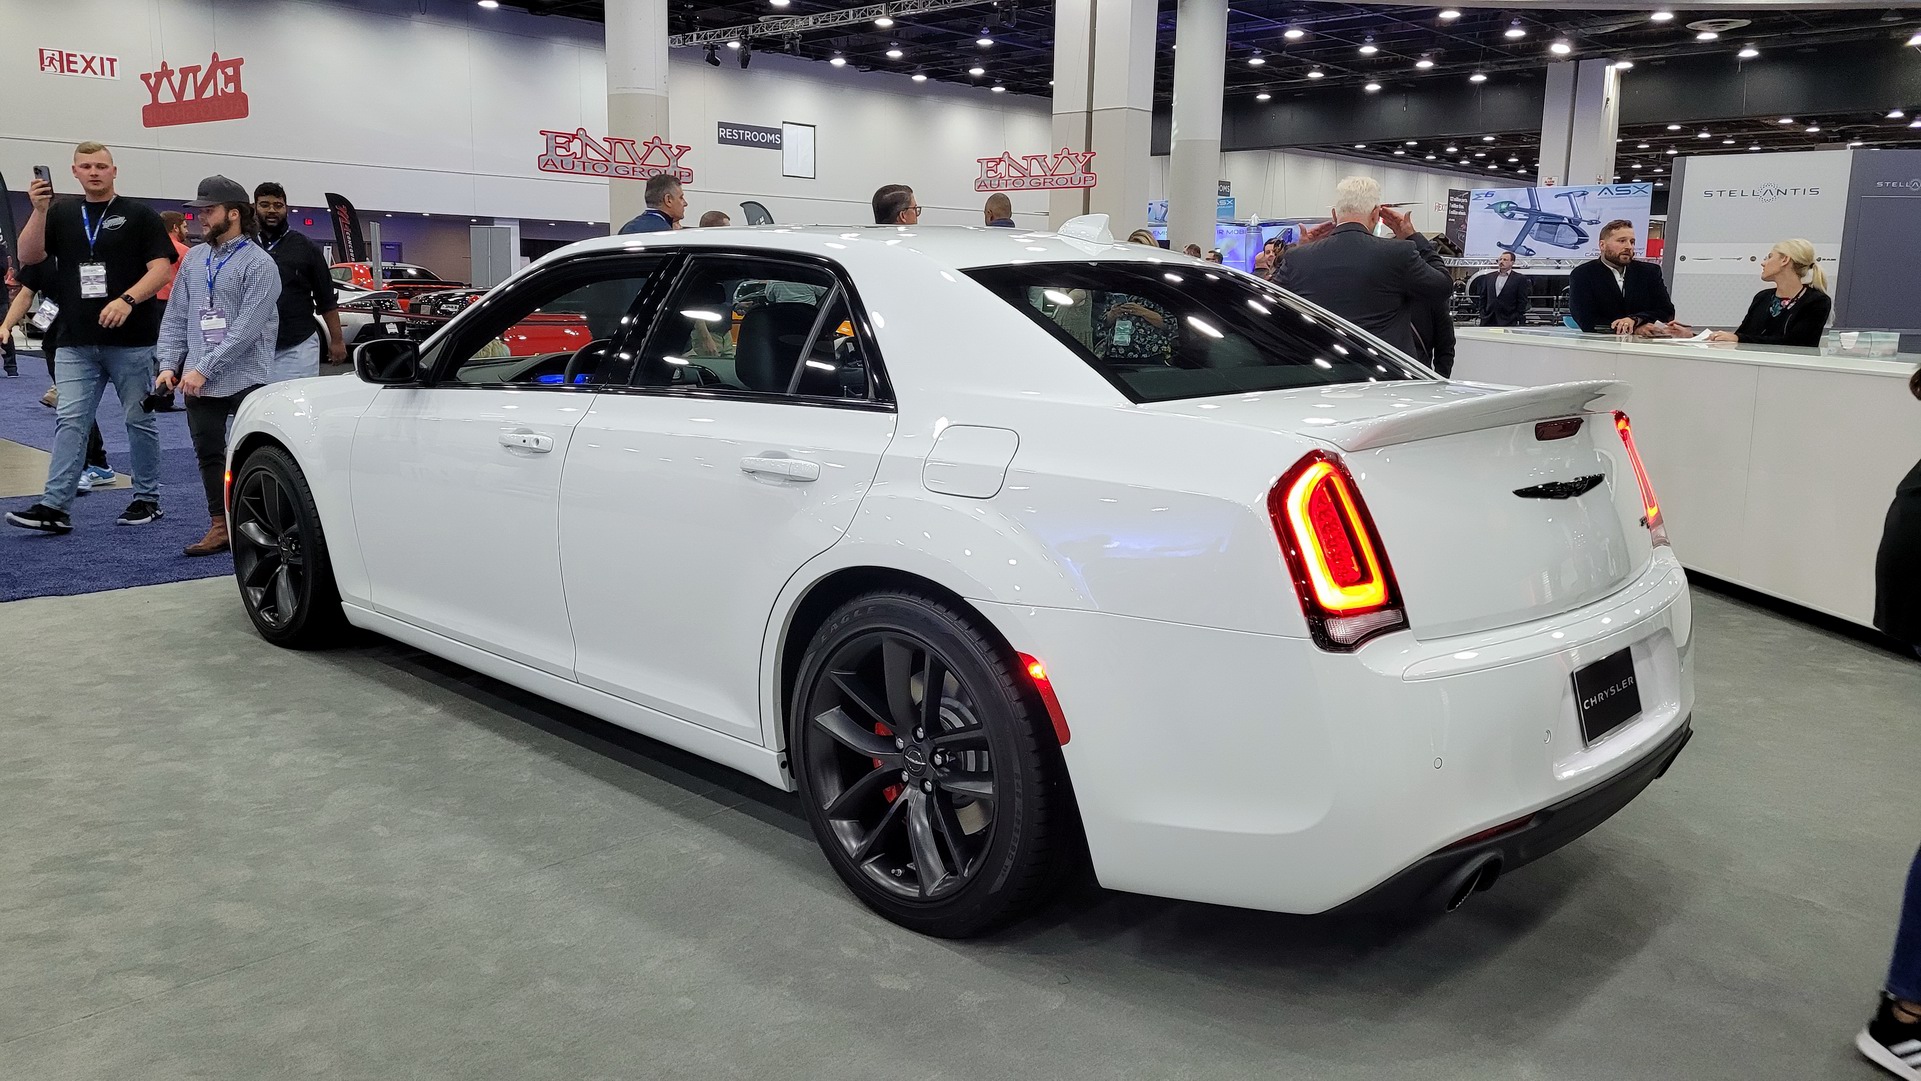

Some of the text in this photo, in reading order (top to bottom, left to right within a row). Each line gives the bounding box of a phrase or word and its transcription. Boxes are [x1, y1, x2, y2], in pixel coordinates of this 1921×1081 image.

[65, 53, 118, 78] EXIT
[718, 127, 782, 144] RESTROOMS
[539, 129, 692, 168] ENVY
[542, 158, 609, 174] AUTO
[976, 151, 1097, 178] ENVY
[976, 175, 1095, 190] AUTO GROUP
[1597, 184, 1650, 197] ASX
[1703, 186, 1821, 198] STELLANTIS
[1583, 676, 1635, 710] CHRYSLER
